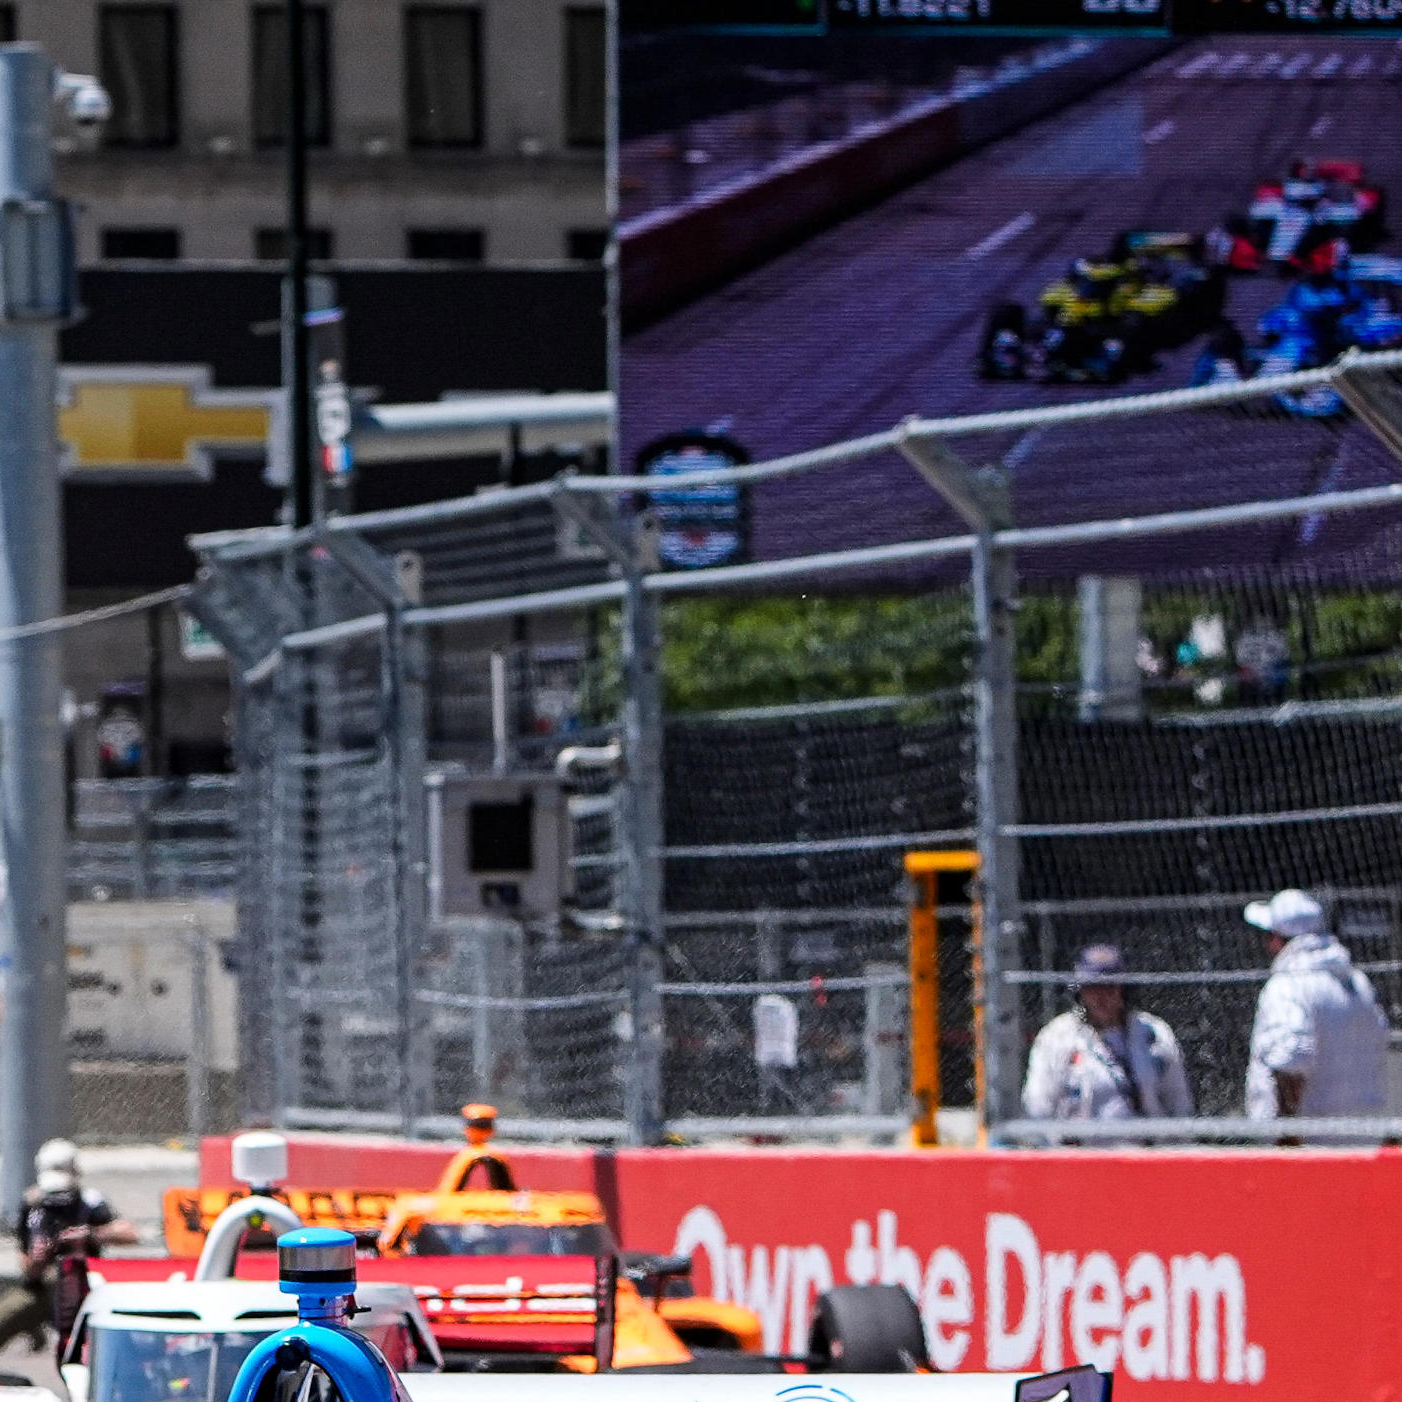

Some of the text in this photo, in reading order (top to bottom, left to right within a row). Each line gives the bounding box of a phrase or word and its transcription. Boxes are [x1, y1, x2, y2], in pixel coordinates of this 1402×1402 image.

[676, 1205, 1266, 1386] Own the Dream.
